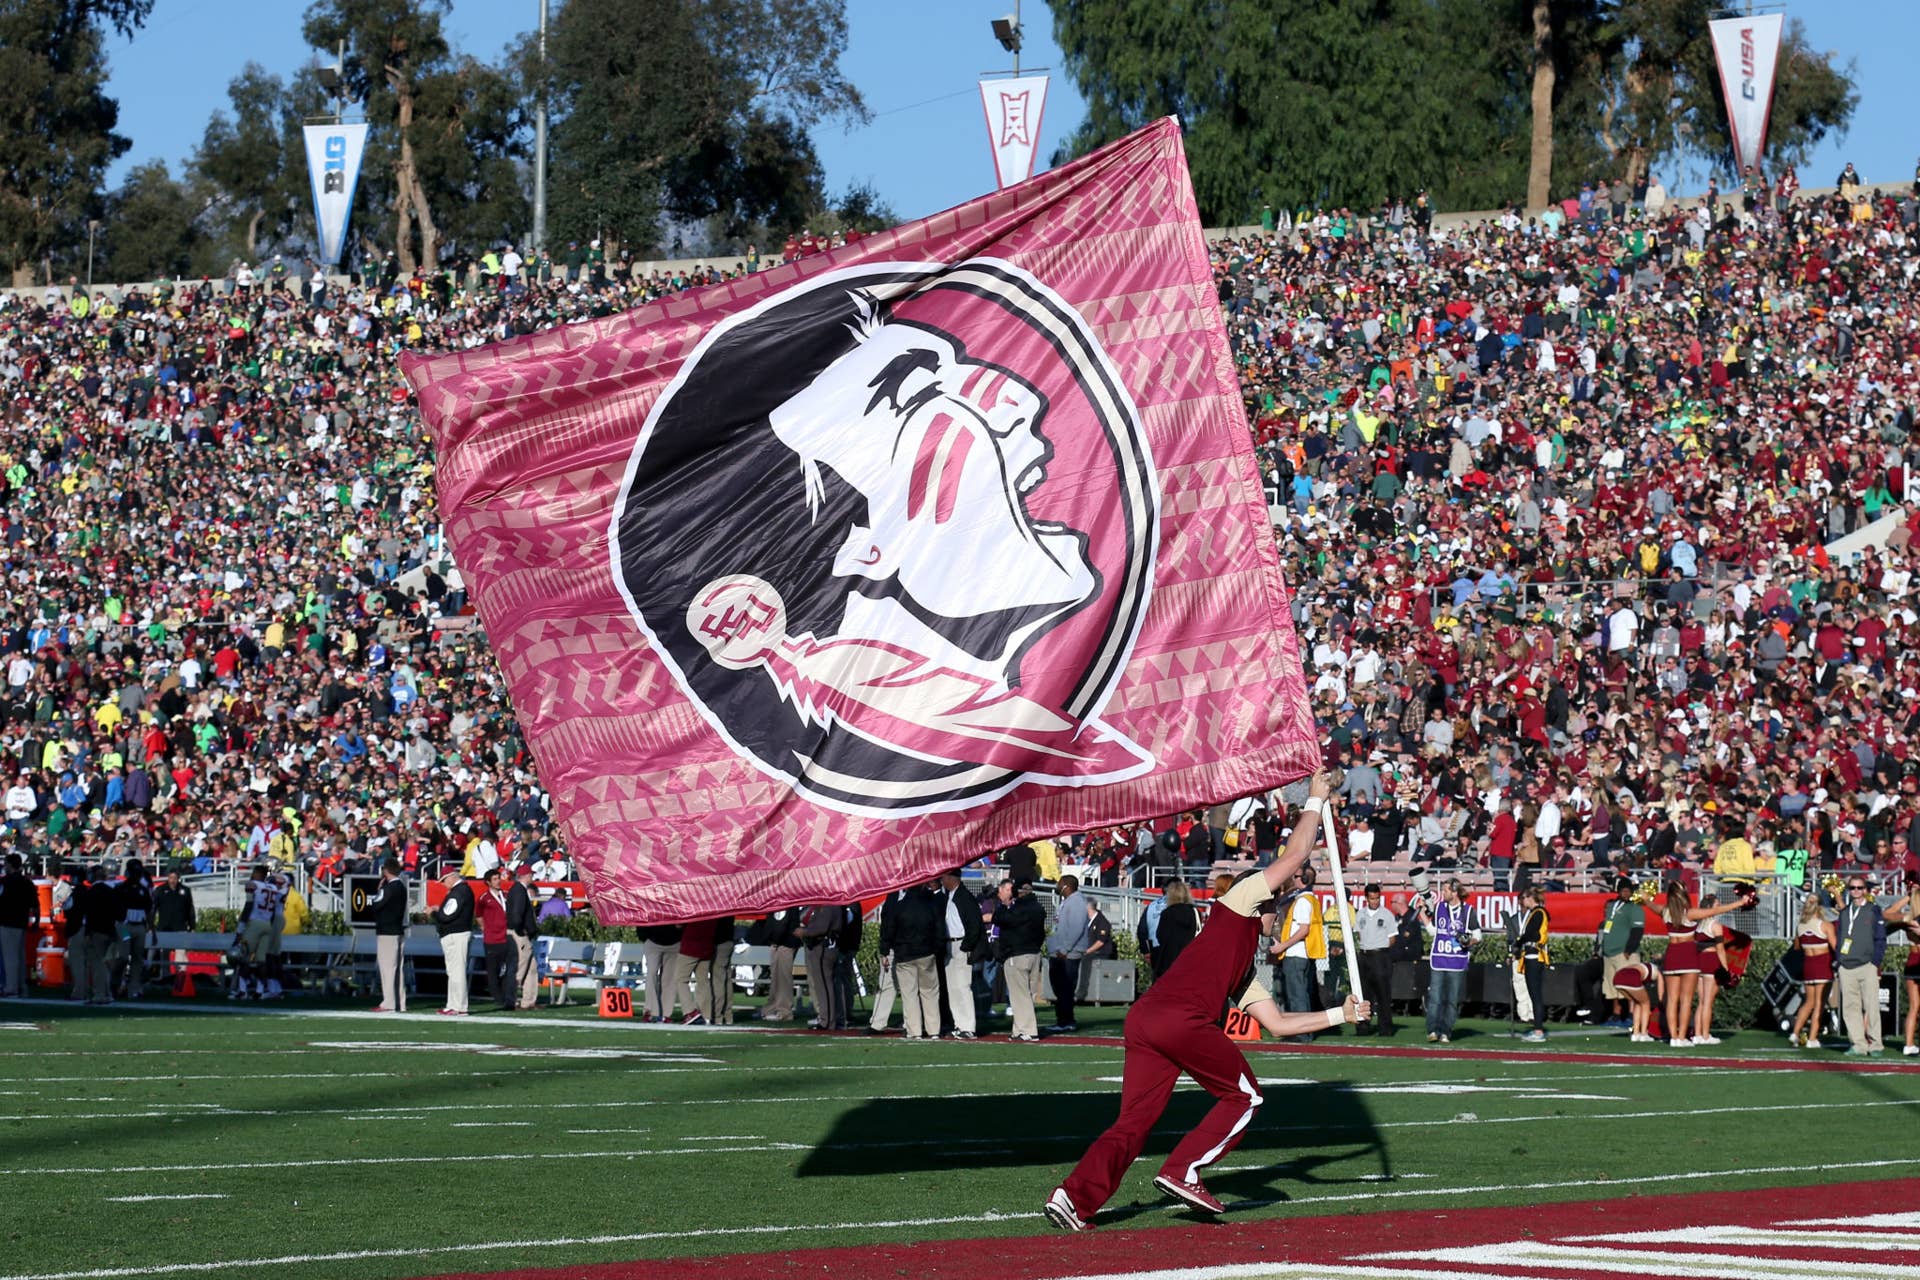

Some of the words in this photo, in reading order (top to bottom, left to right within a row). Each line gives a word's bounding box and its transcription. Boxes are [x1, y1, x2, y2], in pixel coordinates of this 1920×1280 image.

[699, 593, 778, 645] FSU
[1437, 939, 1452, 953] 06
[606, 991, 629, 1013] 30
[1227, 1011, 1250, 1036] 20
